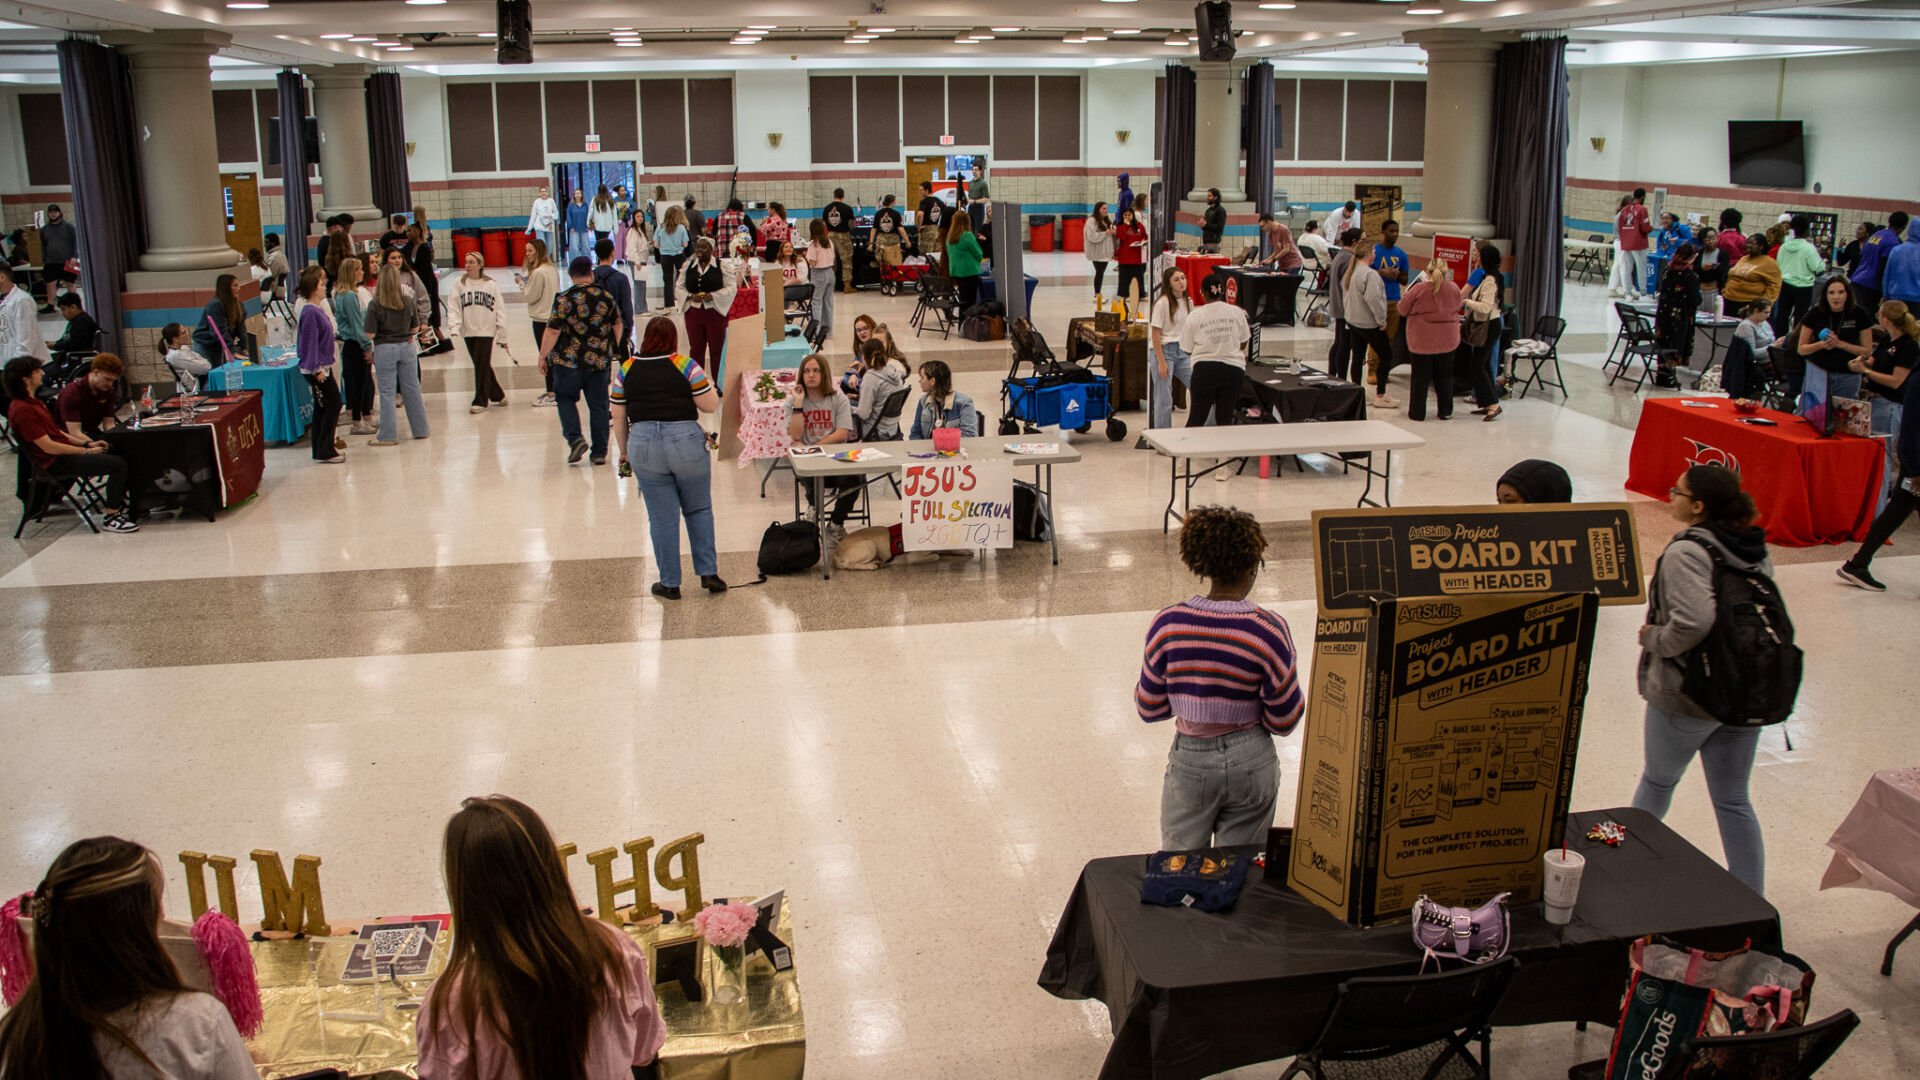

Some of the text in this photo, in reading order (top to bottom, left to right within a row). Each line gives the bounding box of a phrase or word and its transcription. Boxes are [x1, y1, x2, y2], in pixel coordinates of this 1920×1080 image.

[803, 409, 832, 423] YOU
[904, 464, 977, 497] JSU'S
[910, 499, 1011, 524] FULL SPECTRUM
[918, 523, 1009, 546] LGBTQ+
[1409, 523, 1500, 543] ArtSkills Project
[1410, 539, 1577, 570] BOARD KIT
[1592, 530, 1604, 578] INCLUDED
[1602, 532, 1614, 575] HEADER
[1444, 573, 1547, 590] WITH HEADER
[1398, 603, 1462, 621] ArtSkills
[1318, 618, 1367, 635] BOARD KIT
[1333, 643, 1356, 653] HEADER
[1406, 616, 1565, 687] BOARD KIT
[1408, 632, 1454, 660] Project
[1427, 656, 1541, 700] WITH HEADER
[1569, 709, 1580, 739] HEADER
[1376, 722, 1385, 753] HEADER
[1373, 771, 1381, 785] KIT
[1371, 785, 1380, 815] BOARD
[1396, 837, 1529, 860] FOR THE PERFECT PROJECT!
[1402, 827, 1525, 848] THE COMPLETE SOLUTION
